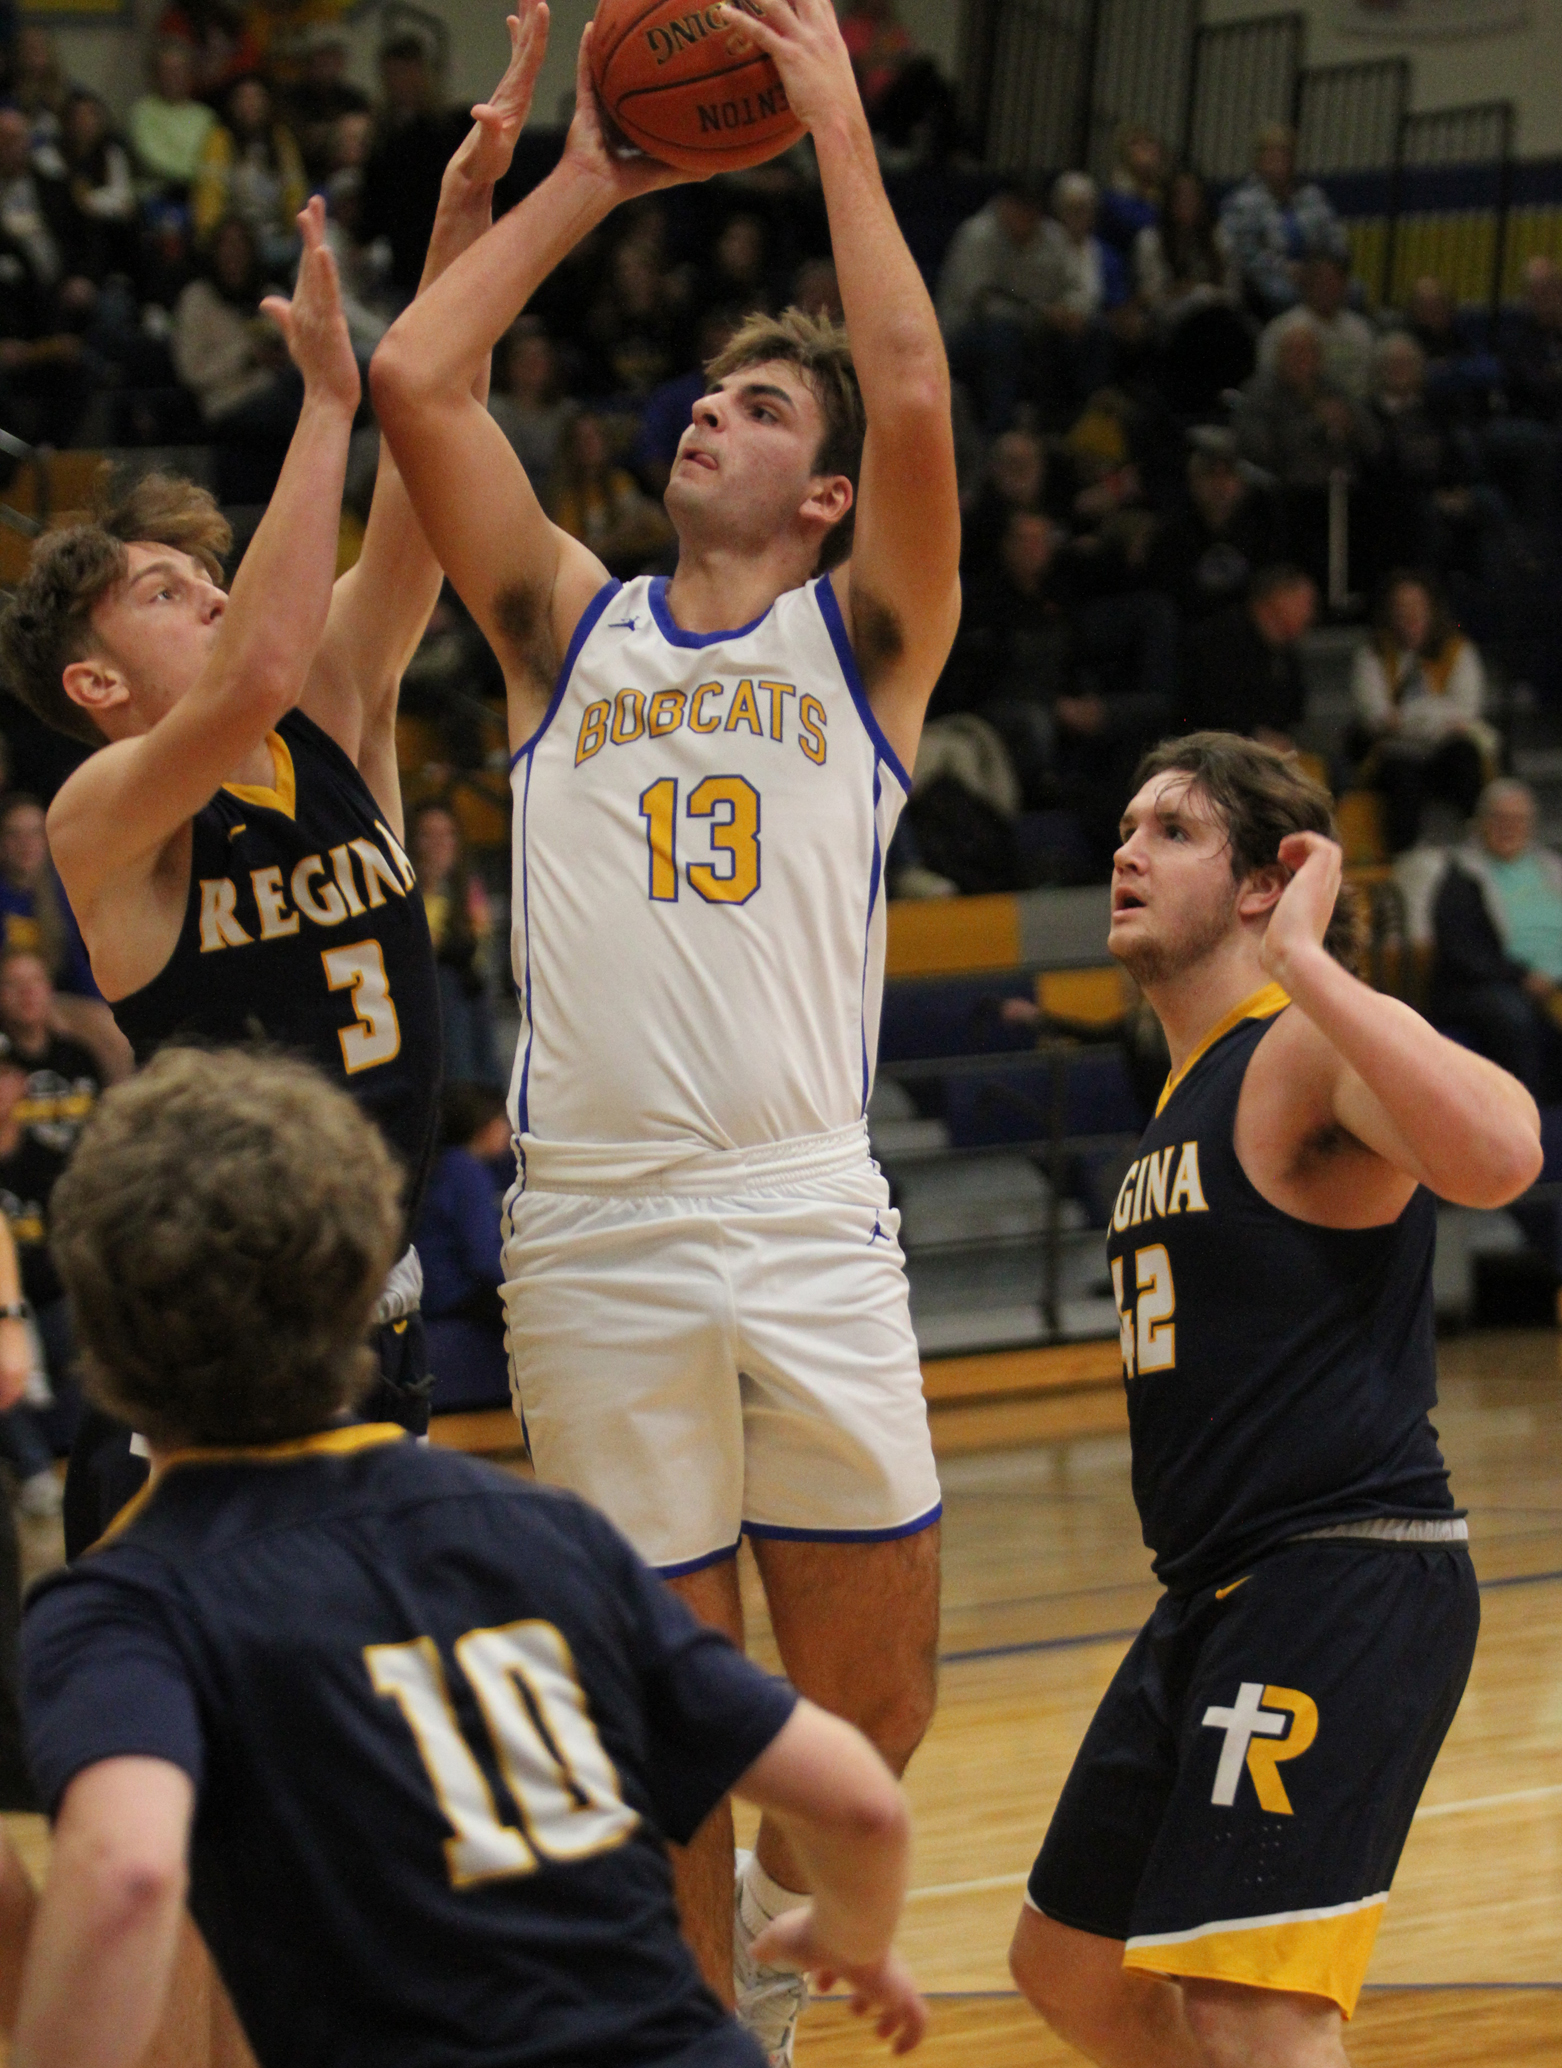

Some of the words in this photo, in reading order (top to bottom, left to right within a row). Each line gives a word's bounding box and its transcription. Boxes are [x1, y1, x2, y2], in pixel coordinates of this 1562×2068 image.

[696, 80, 790, 133] ENTON
[574, 679, 827, 768] BOBCATS
[639, 774, 761, 906] 13
[320, 938, 401, 1075] 3
[1107, 1141, 1209, 1240] GINA
[363, 1617, 641, 1890] 10
